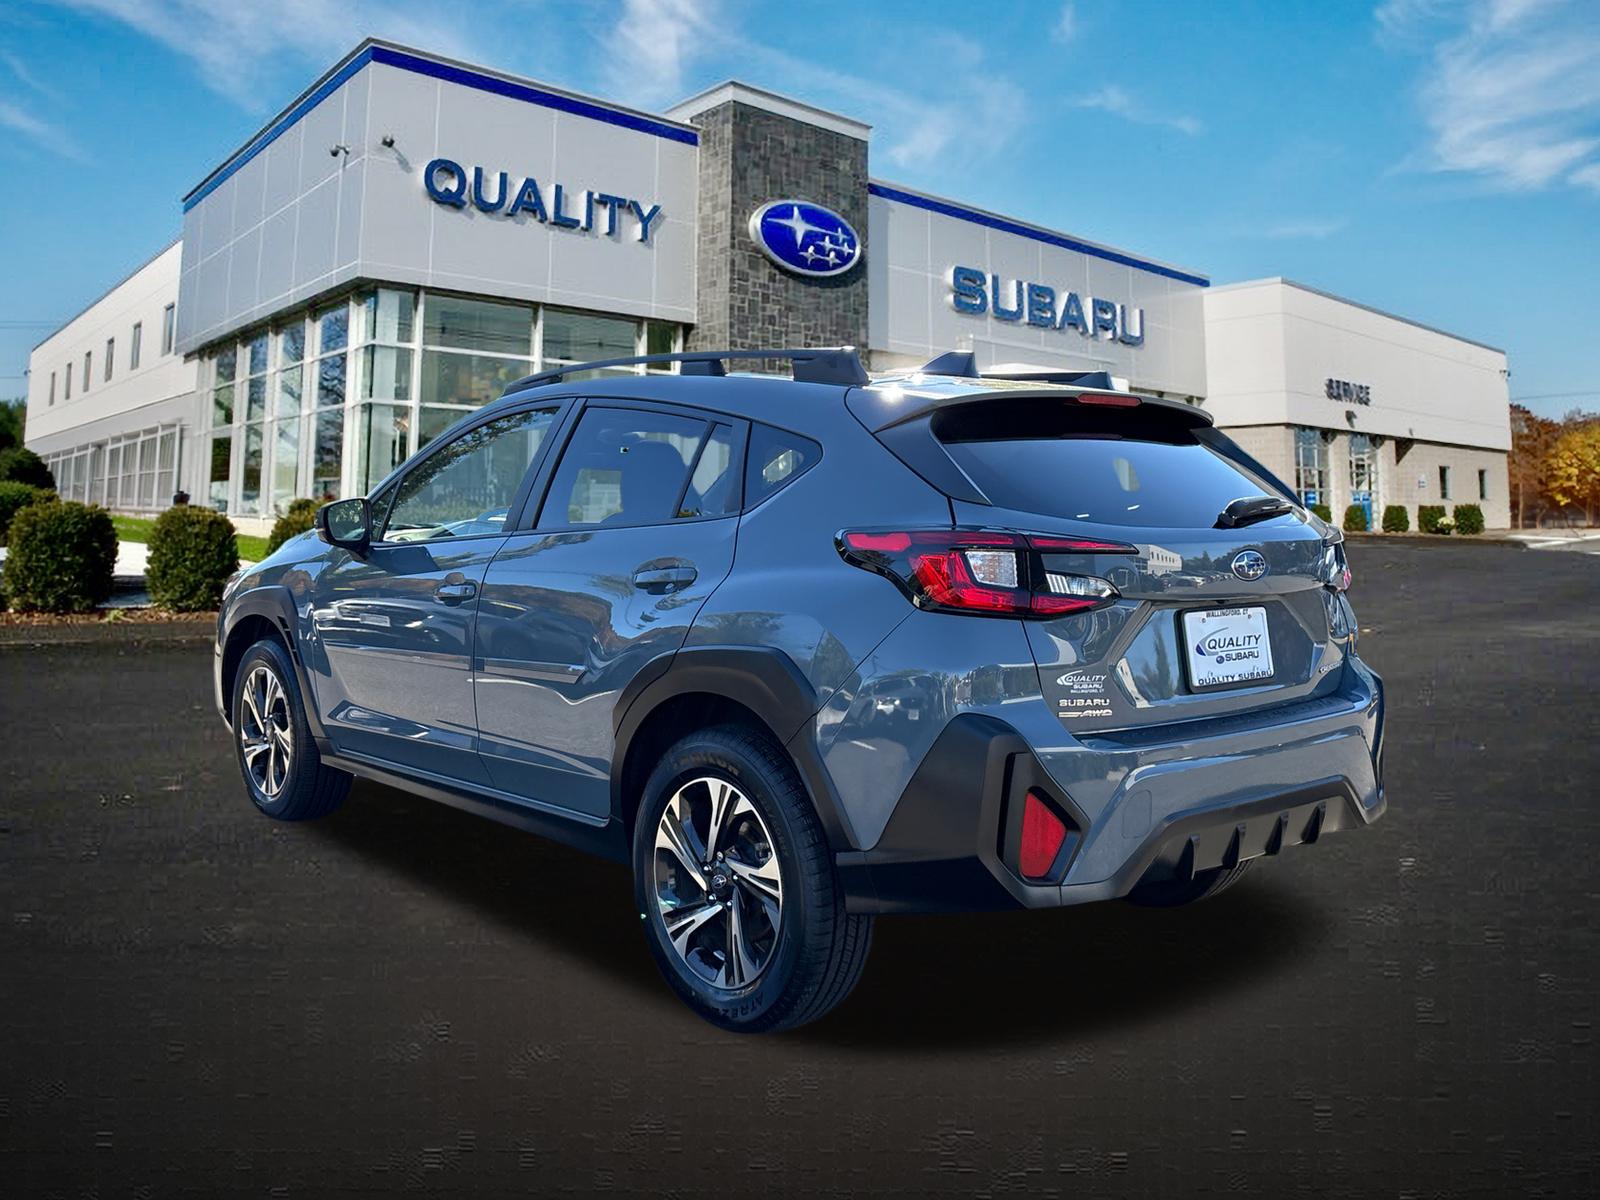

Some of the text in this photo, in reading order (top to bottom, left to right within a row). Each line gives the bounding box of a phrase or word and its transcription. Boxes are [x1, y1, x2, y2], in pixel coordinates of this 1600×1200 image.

[424, 158, 662, 242] QUALITY
[951, 265, 1145, 346] SUBARU
[1326, 378, 1371, 406] SERVICE
[1207, 634, 1261, 650] QUALITY
[1225, 650, 1260, 662] SUBARU
[1065, 674, 1107, 682] QUALITY
[1198, 674, 1236, 685] QUALITY
[1238, 669, 1273, 681] SUBARU
[1059, 698, 1110, 707] SUBARU
